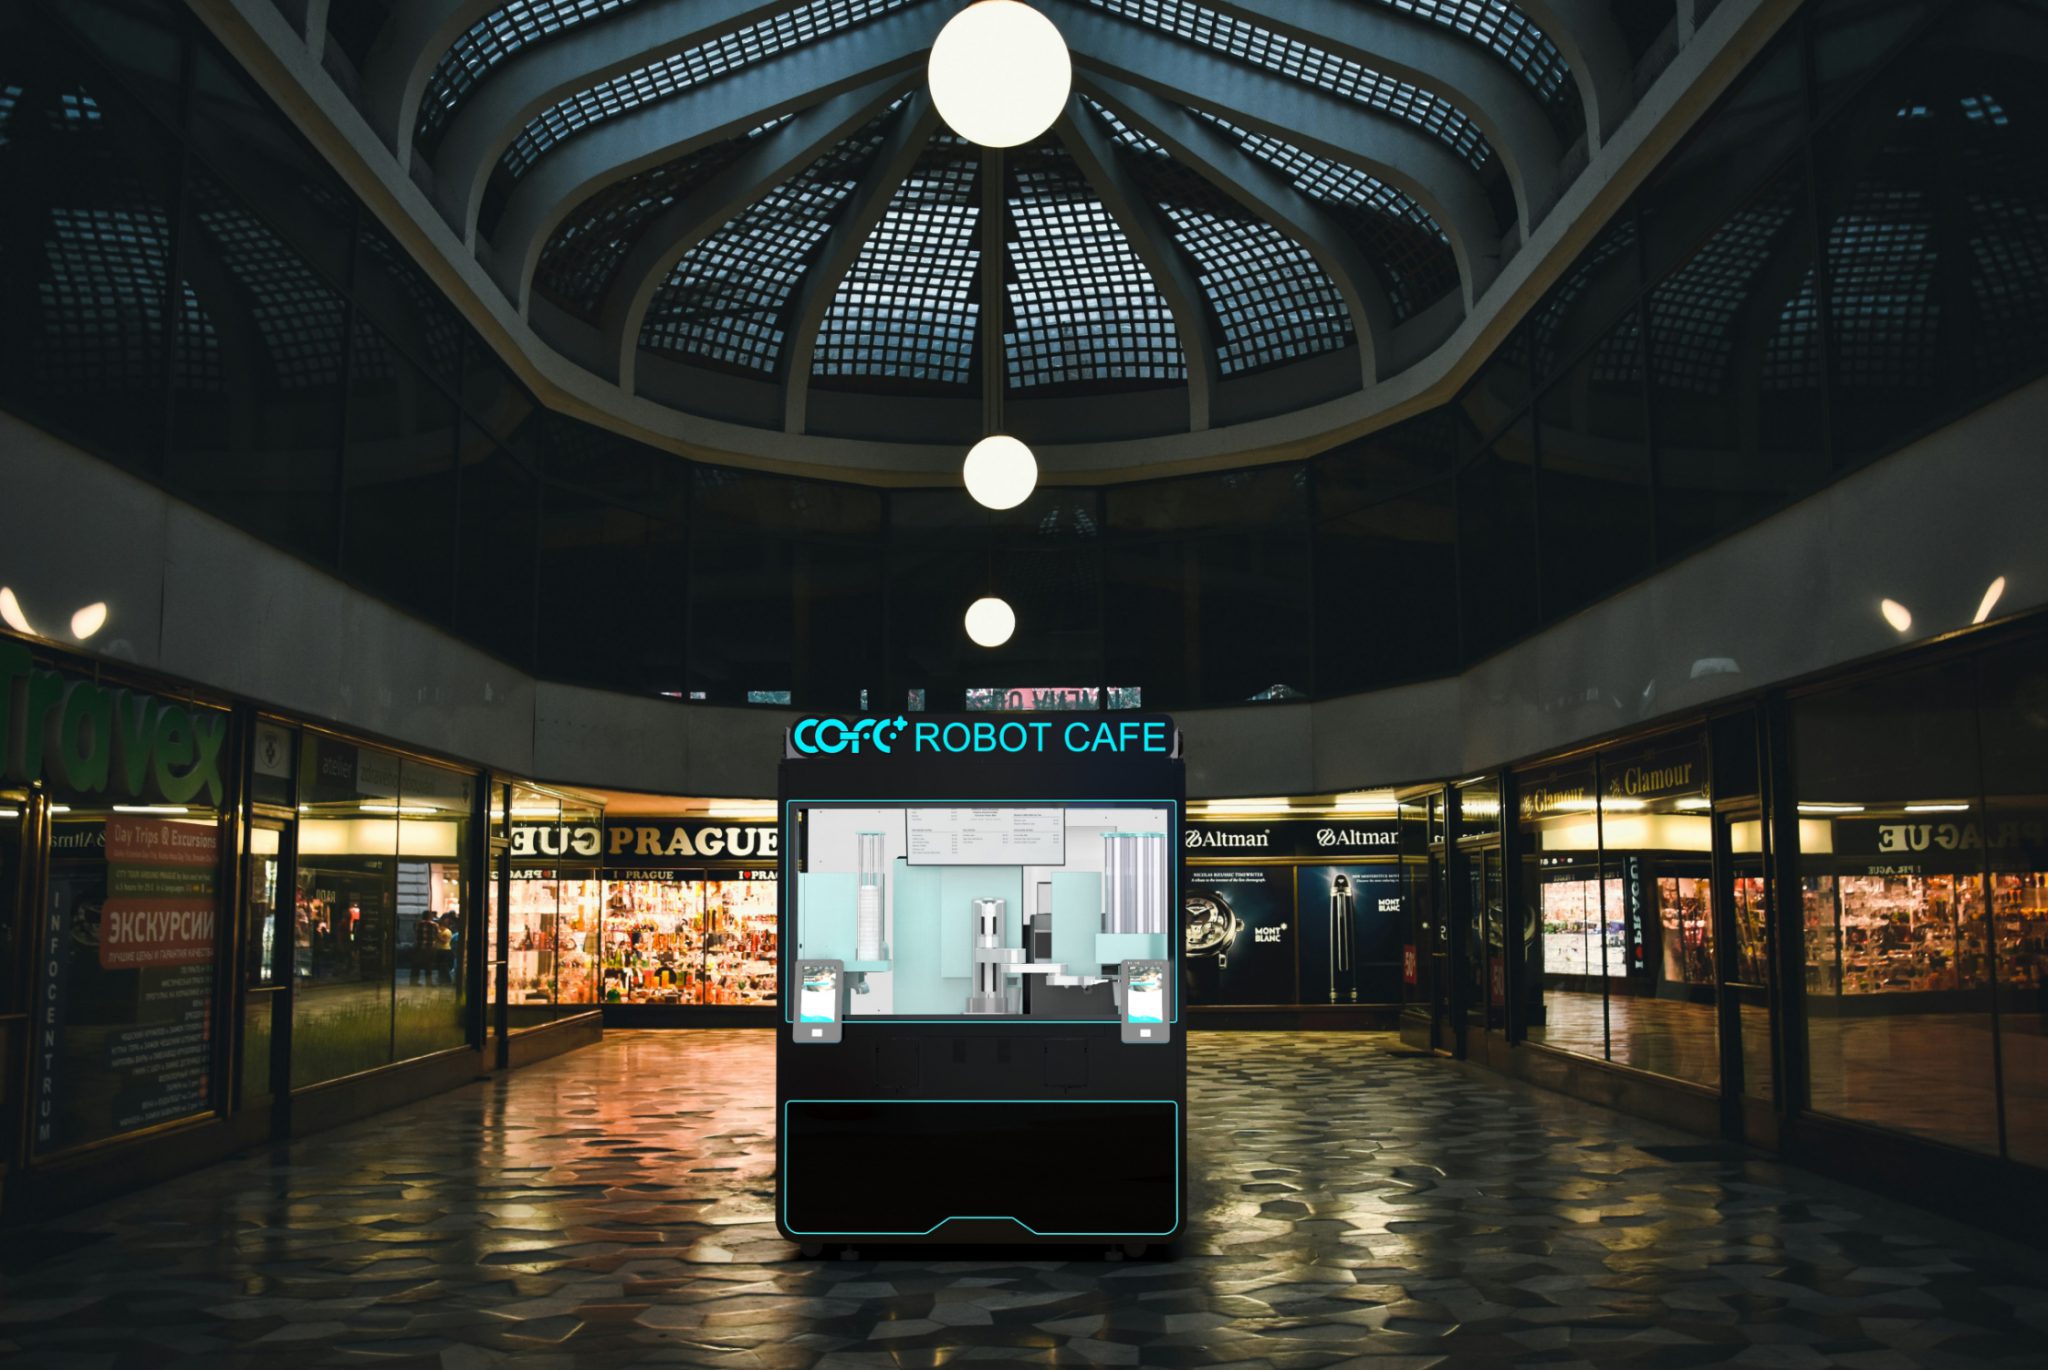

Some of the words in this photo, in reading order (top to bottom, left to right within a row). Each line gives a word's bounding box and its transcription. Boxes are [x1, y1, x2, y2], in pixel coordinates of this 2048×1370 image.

[914, 721, 1052, 752] ROBOT
[1064, 721, 1167, 752] CAFE
[1624, 762, 1693, 795] Glamour
[1534, 786, 1585, 813] Glamour
[114, 824, 132, 846] Day
[135, 826, 159, 848] Trips
[171, 829, 217, 849] Excursions
[608, 827, 778, 857] PRAGUE
[1202, 831, 1270, 848] Altman
[625, 870, 675, 880] PRAGUE
[750, 870, 778, 880] PRA
[1379, 904, 1400, 912] BLANC
[108, 911, 215, 944] ЭКСКУРСИИ
[1254, 927, 1281, 935] MONT
[1254, 934, 1281, 943] BLANC
[39, 891, 60, 1141] INFOCENTRUM
